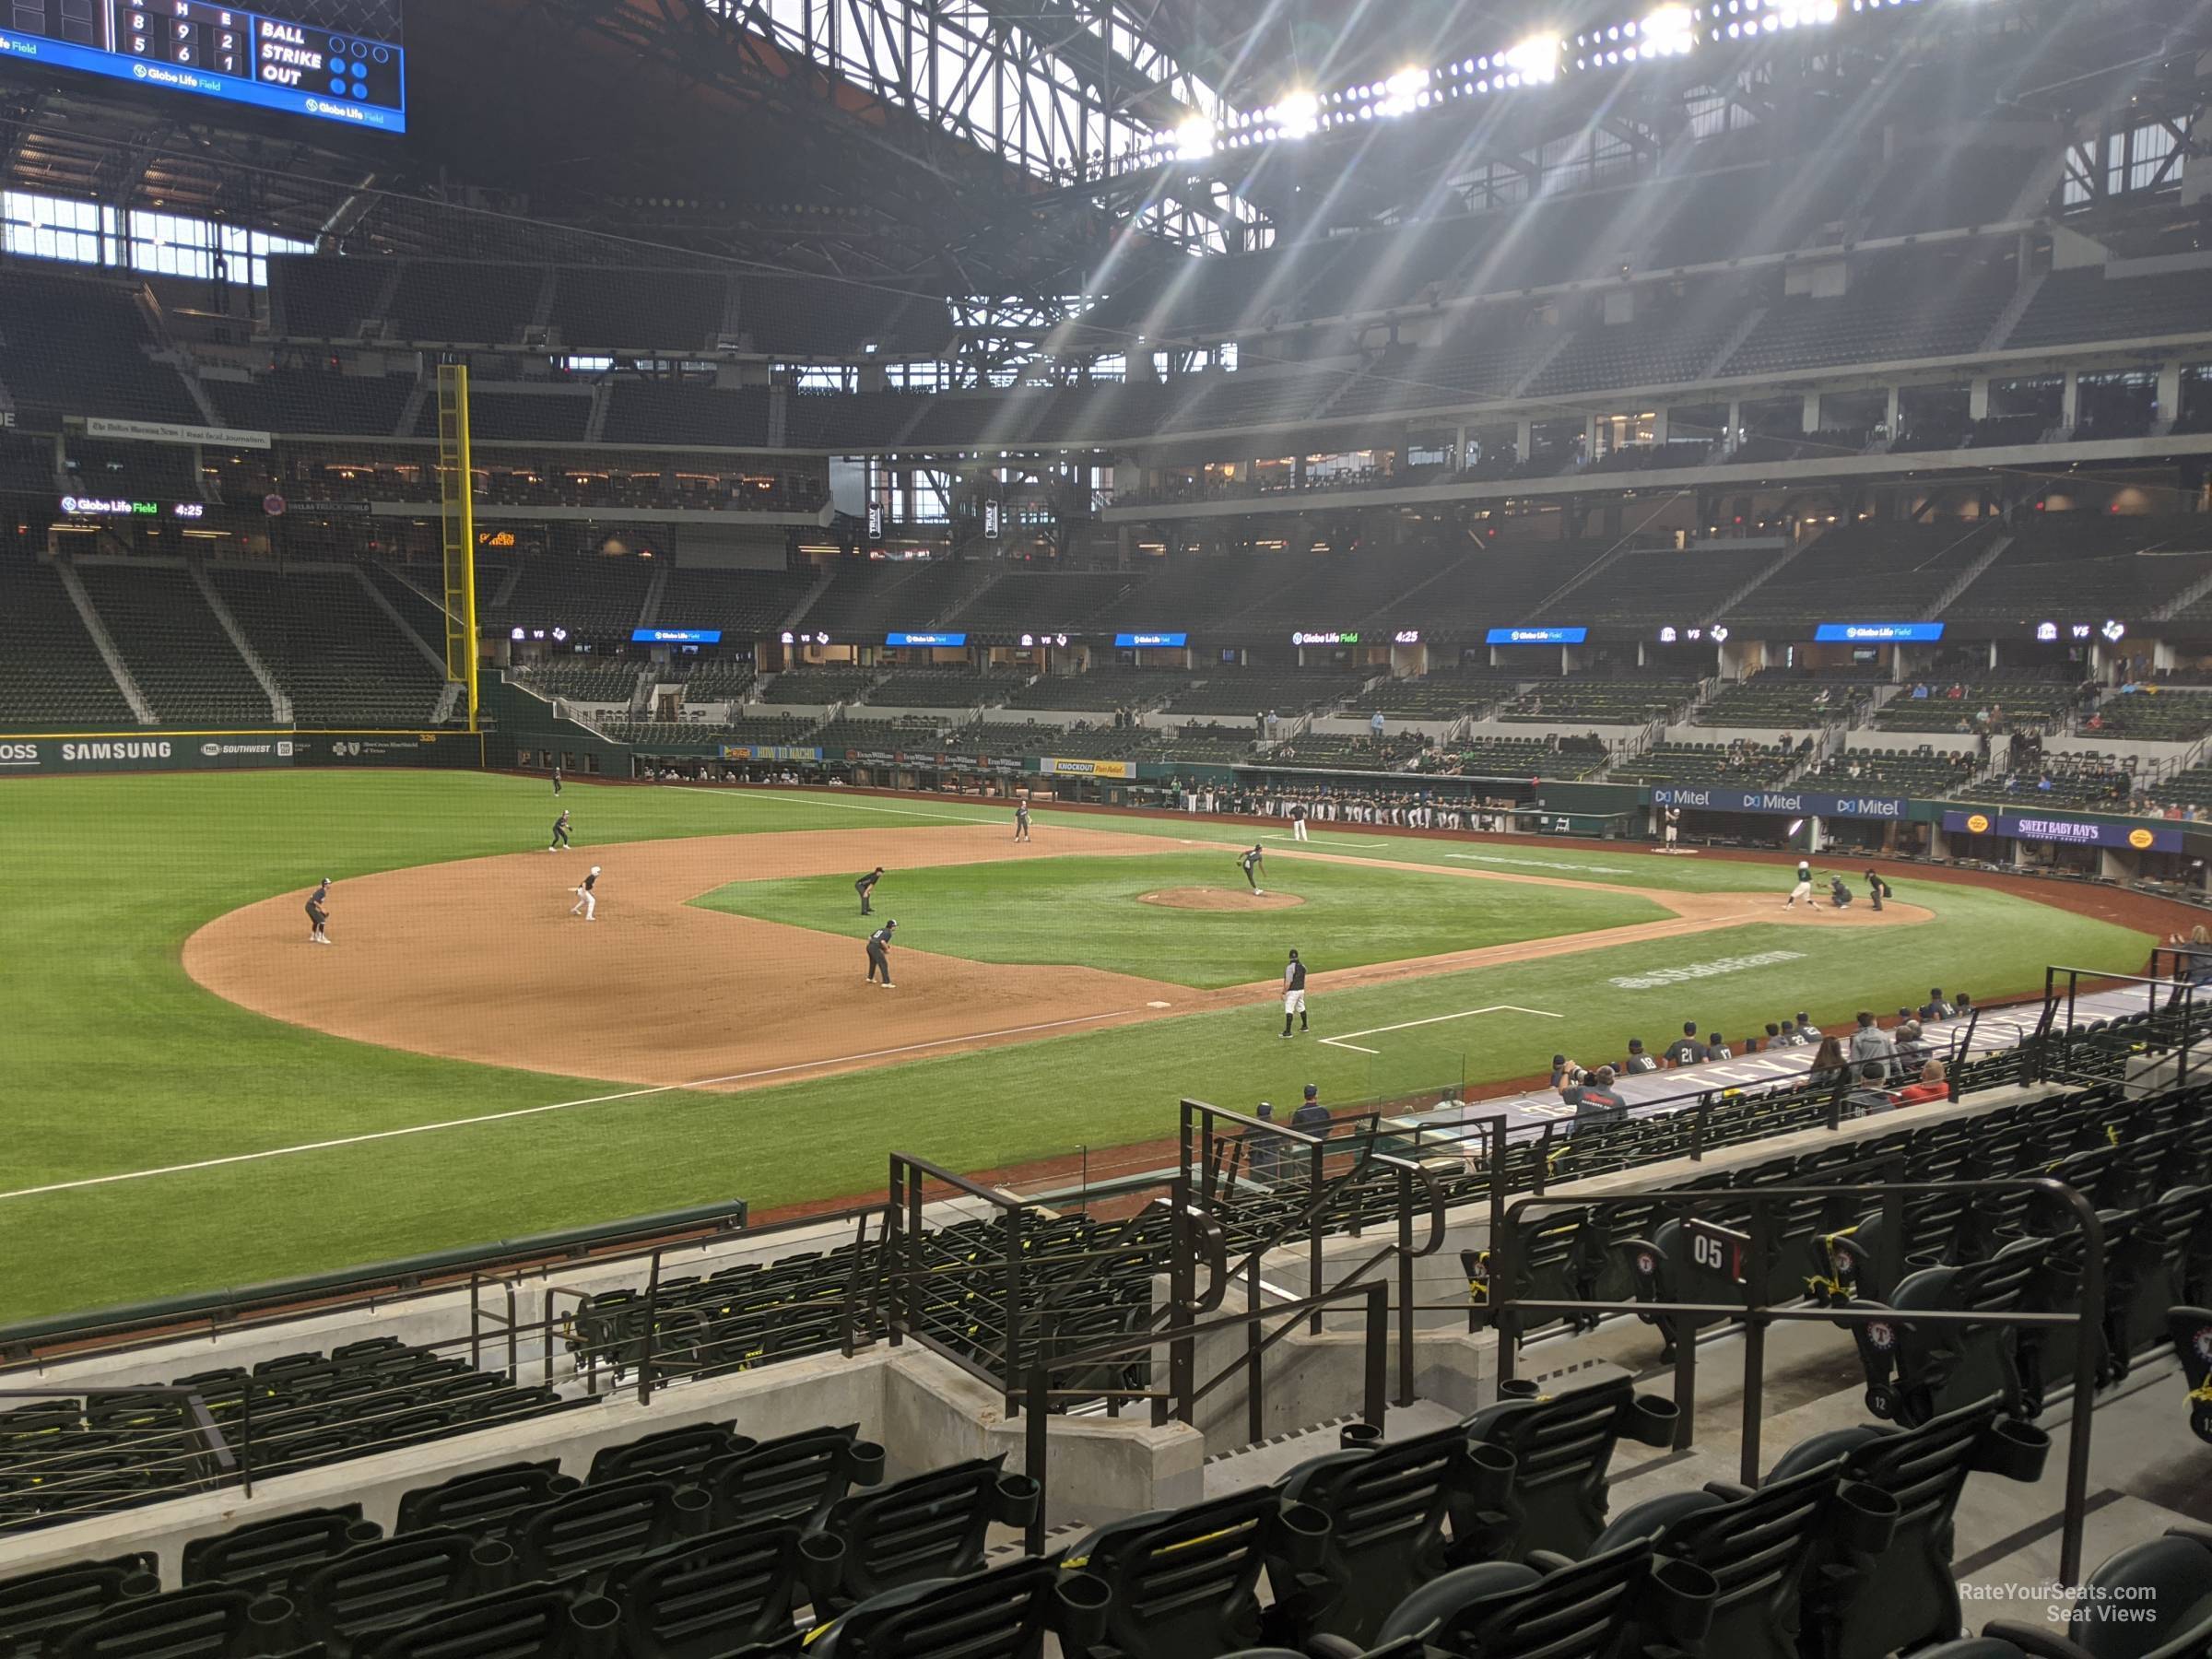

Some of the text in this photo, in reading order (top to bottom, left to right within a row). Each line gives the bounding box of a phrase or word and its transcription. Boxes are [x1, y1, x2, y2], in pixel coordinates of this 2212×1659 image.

[177, 3, 231, 26] H E
[134, 15, 232, 49] 8 9 2
[262, 21, 304, 44] BALL
[12, 41, 37, 54] Field
[135, 38, 233, 71] 5 6 1
[262, 44, 322, 69] STRIKE
[148, 67, 221, 91] Globe Life Field
[263, 65, 301, 85] OUT
[319, 102, 346, 116] Globe
[347, 108, 363, 120] Life
[77, 500, 158, 513] Globe Life Field
[175, 504, 203, 516] 4:25
[1302, 632, 1358, 643] Globe Life Field
[1394, 631, 1418, 642] 4:25
[1536, 631, 1547, 640] Life
[1856, 628, 1912, 637] Globe Life Field
[63, 742, 171, 760] SAMSUNG
[223, 745, 271, 753] SOUTHWEST
[758, 746, 774, 759] HOW
[779, 747, 787, 759] TO
[1058, 762, 1094, 771] KNOCKOUT
[1674, 791, 1710, 805] Mitel
[1763, 794, 1802, 810] Mitel
[1858, 799, 1900, 816] Mitel
[2018, 819, 2099, 839] SWEET BABY RAY'S
[1681, 1048, 1693, 1063] 21
[1720, 1049, 1732, 1060] 17
[1641, 1057, 1657, 1069] 18
[1694, 1235, 1723, 1269] 05
[1876, 1395, 1886, 1410] 12
